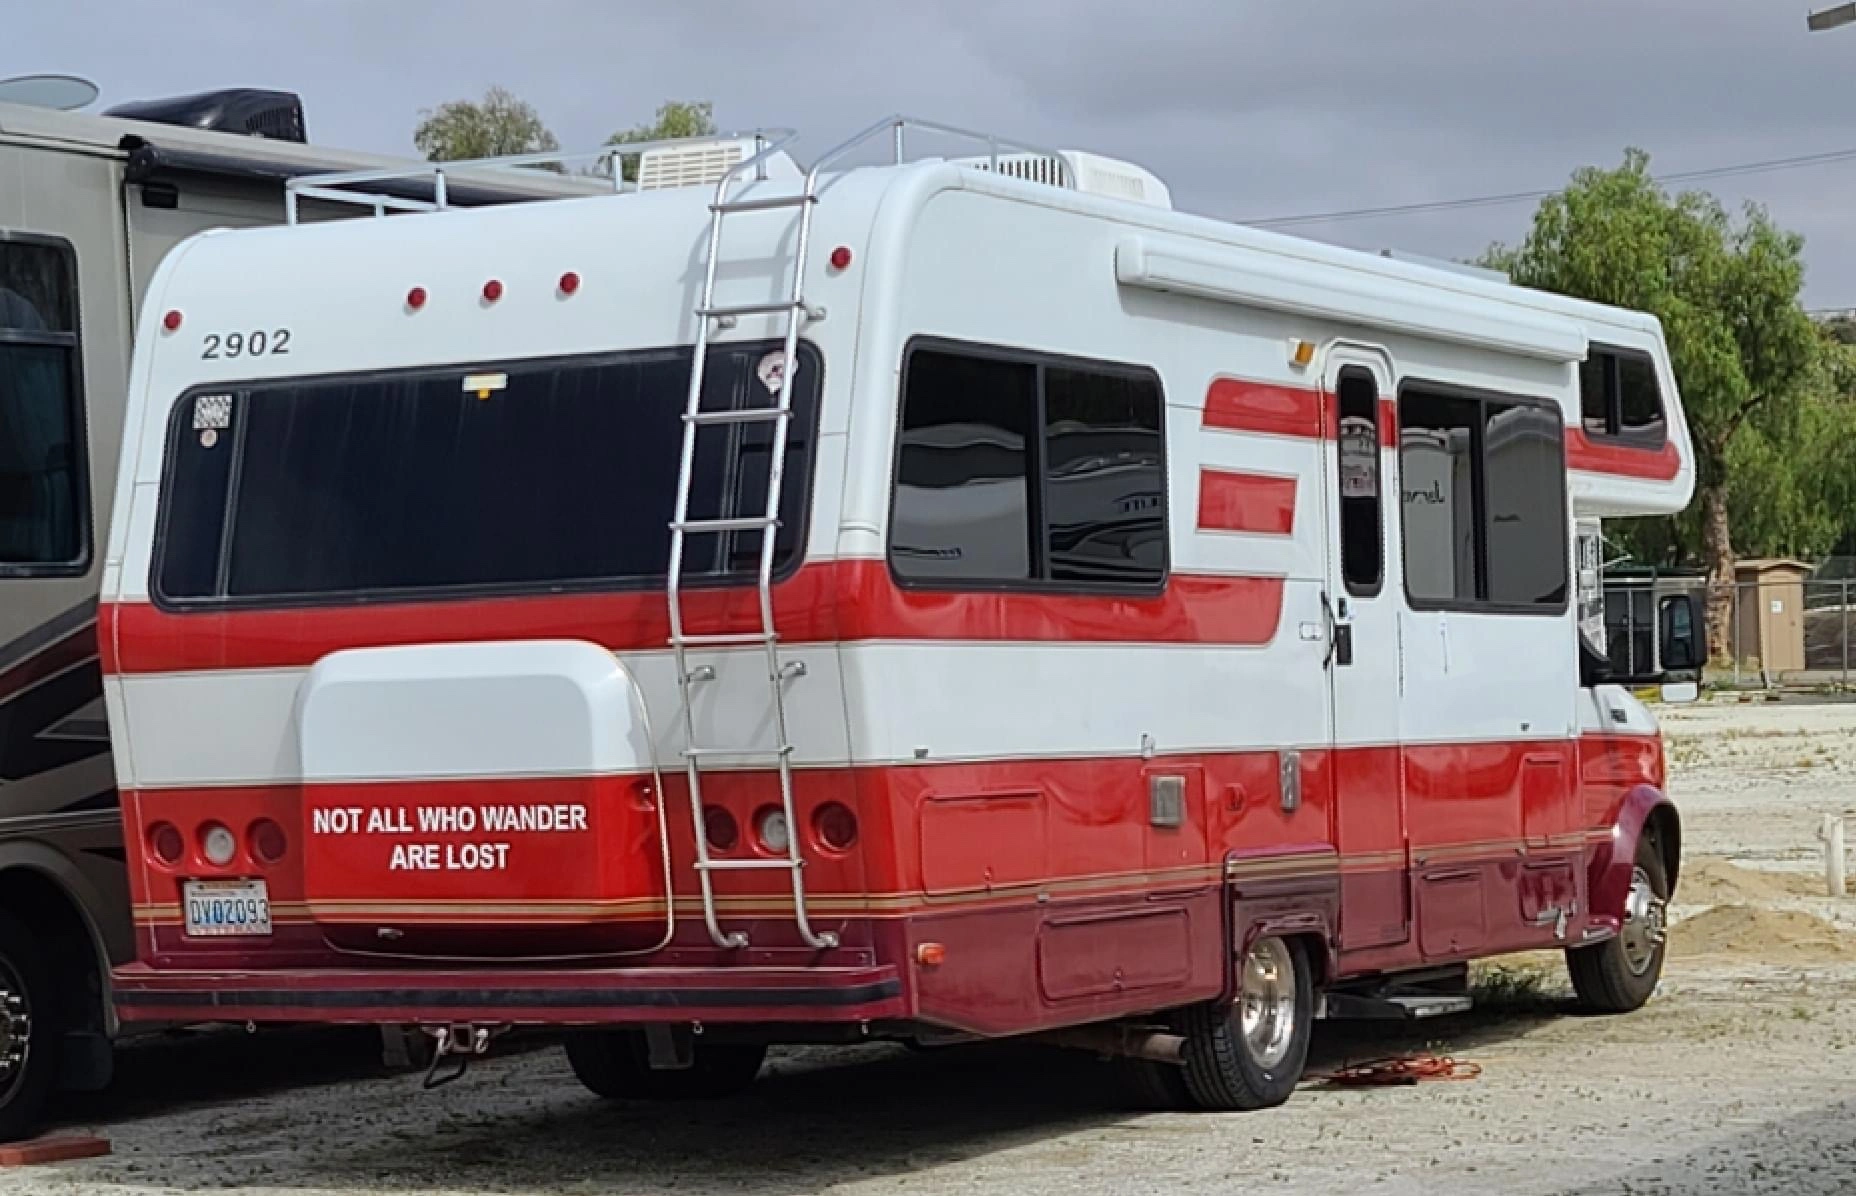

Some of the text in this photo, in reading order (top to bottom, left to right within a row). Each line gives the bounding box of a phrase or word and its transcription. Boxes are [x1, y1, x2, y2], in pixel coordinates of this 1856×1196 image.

[201, 328, 290, 360] 2902
[312, 804, 588, 833] NOT ALL WHO WANDER
[390, 843, 510, 869] ARE LOST
